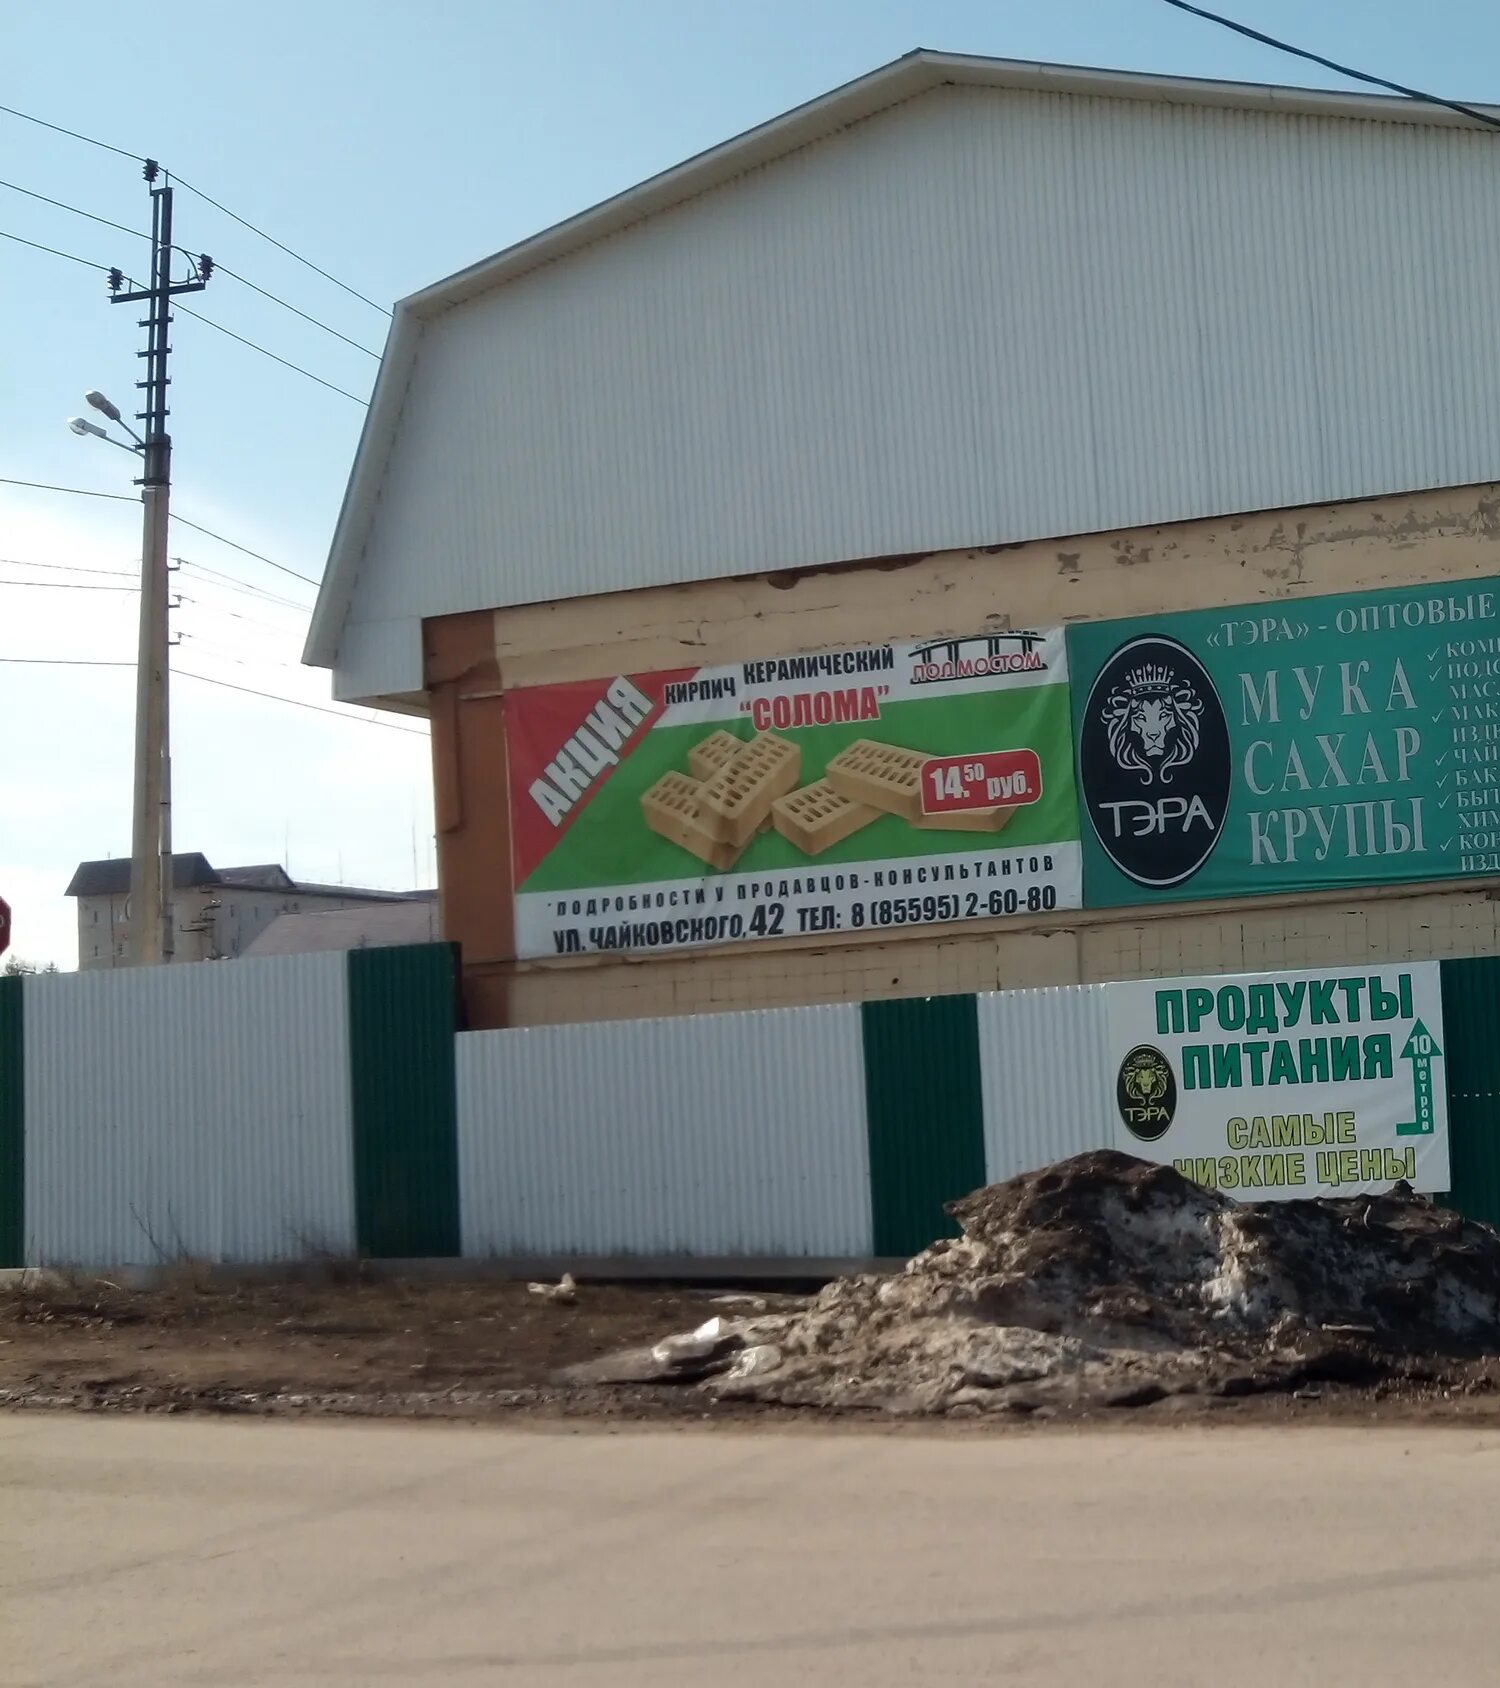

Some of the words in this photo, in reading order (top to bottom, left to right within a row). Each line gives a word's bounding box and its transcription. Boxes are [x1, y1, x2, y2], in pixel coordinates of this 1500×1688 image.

[1206, 617, 1309, 649] «ТЭРА»
[1335, 592, 1496, 635] ОПТОВЫЕ
[665, 677, 736, 704] КИРПИЧ
[743, 644, 894, 684] КЕРАМИЧЕСКИЙ
[1239, 656, 1418, 727] МУКА
[529, 675, 654, 827] АКЦИЯ
[1244, 725, 1422, 796] САХАР
[987, 771, 1032, 800] руб.
[1099, 793, 1215, 838] ТЭРА
[1247, 796, 1428, 866] КРУПЫ
[553, 928, 586, 953] УЛ.
[749, 903, 785, 936] 42
[797, 906, 841, 932] ТЕЛ:
[851, 902, 864, 927] 8
[871, 894, 959, 926] (85595)
[965, 885, 1056, 917] 2-60-80
[715, 886, 724, 902] У
[1155, 974, 1414, 1035] ПРОДУКТЫ
[1181, 1033, 1394, 1090] ПИТАНИЯ
[1409, 1034, 1431, 1055] 10
[1124, 1106, 1170, 1122] ТЭРА
[1226, 1111, 1357, 1150] САМЫЕ
[1316, 1146, 1416, 1187] ЦЕНЫ
